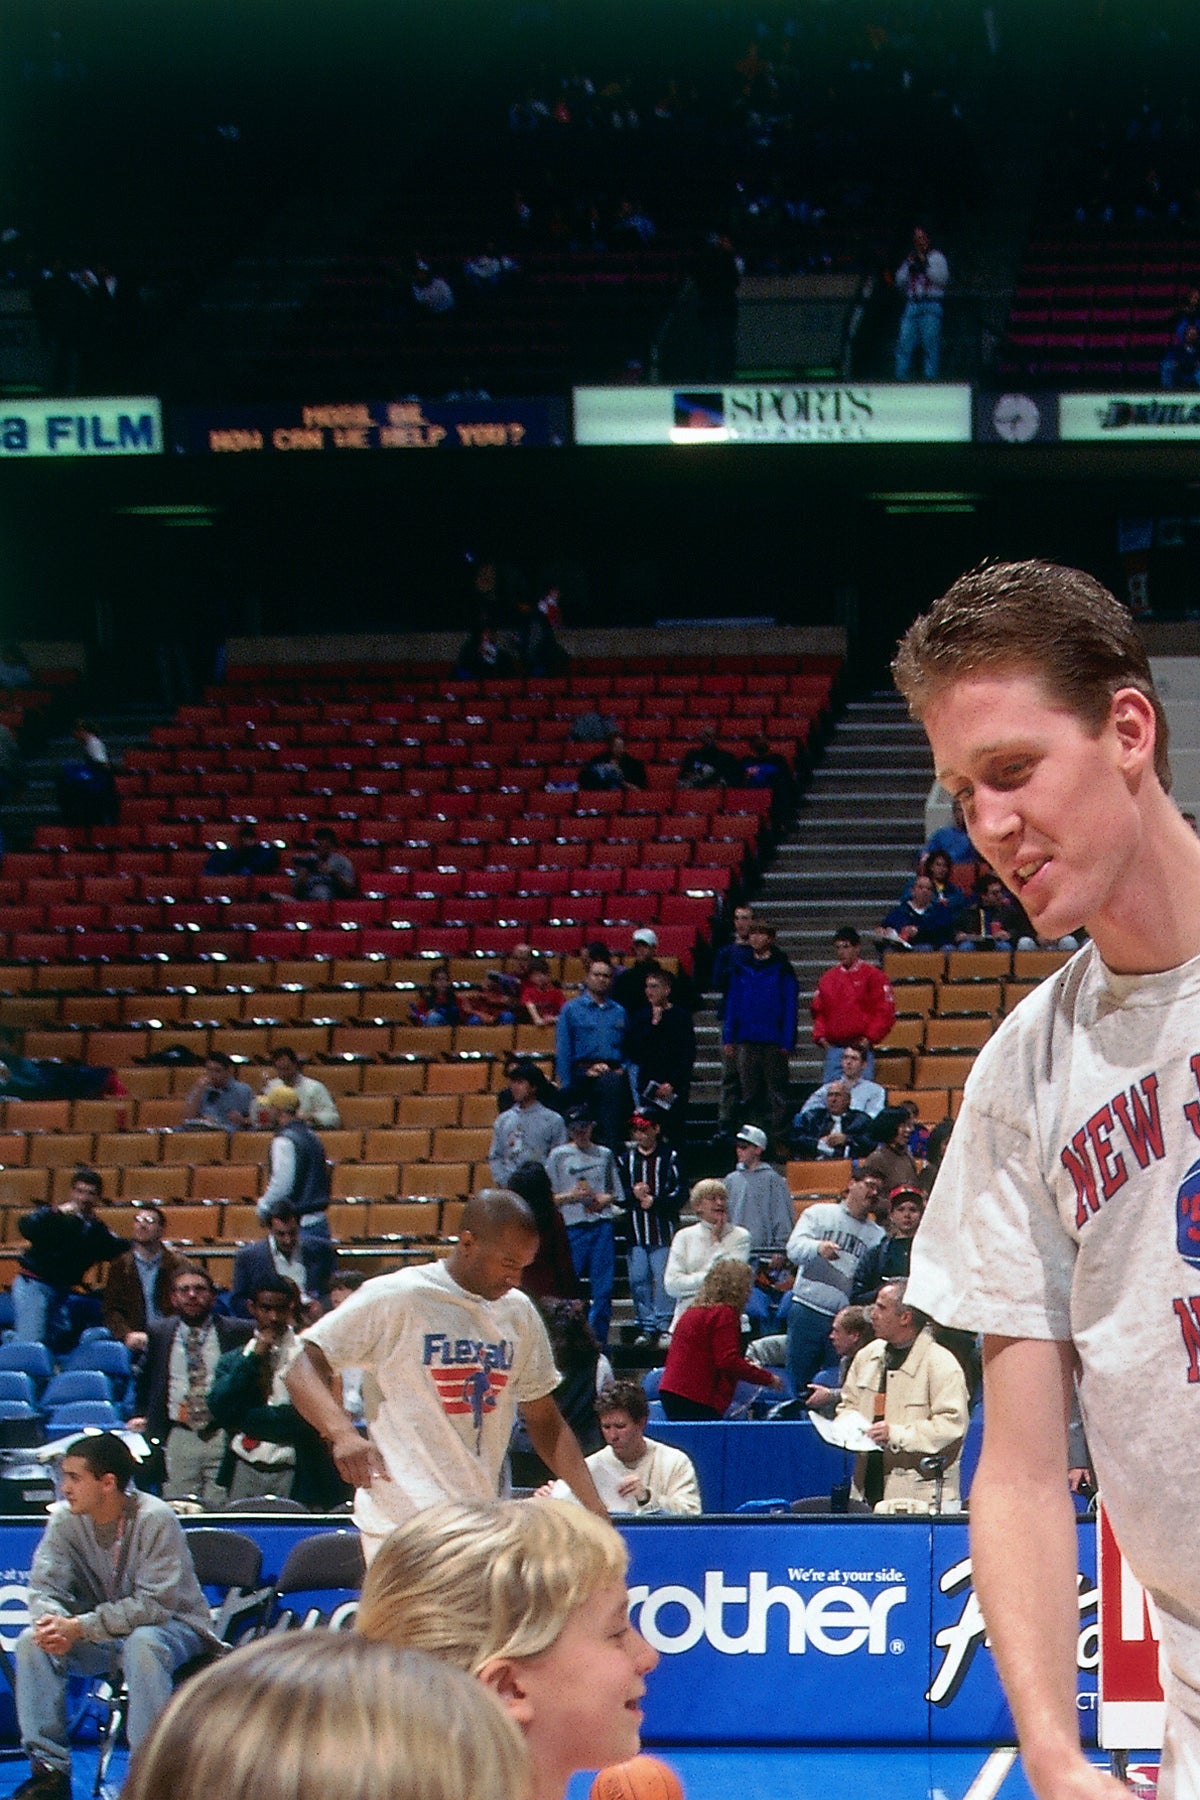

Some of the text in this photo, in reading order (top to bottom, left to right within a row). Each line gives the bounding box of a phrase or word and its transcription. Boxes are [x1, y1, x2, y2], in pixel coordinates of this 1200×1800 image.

[731, 390, 874, 424] SPORTS
[47, 414, 154, 449] FILM
[1060, 1072, 1166, 1231] NEW
[788, 1567, 905, 1585] We're at your side.
[627, 1570, 906, 1655] rother
